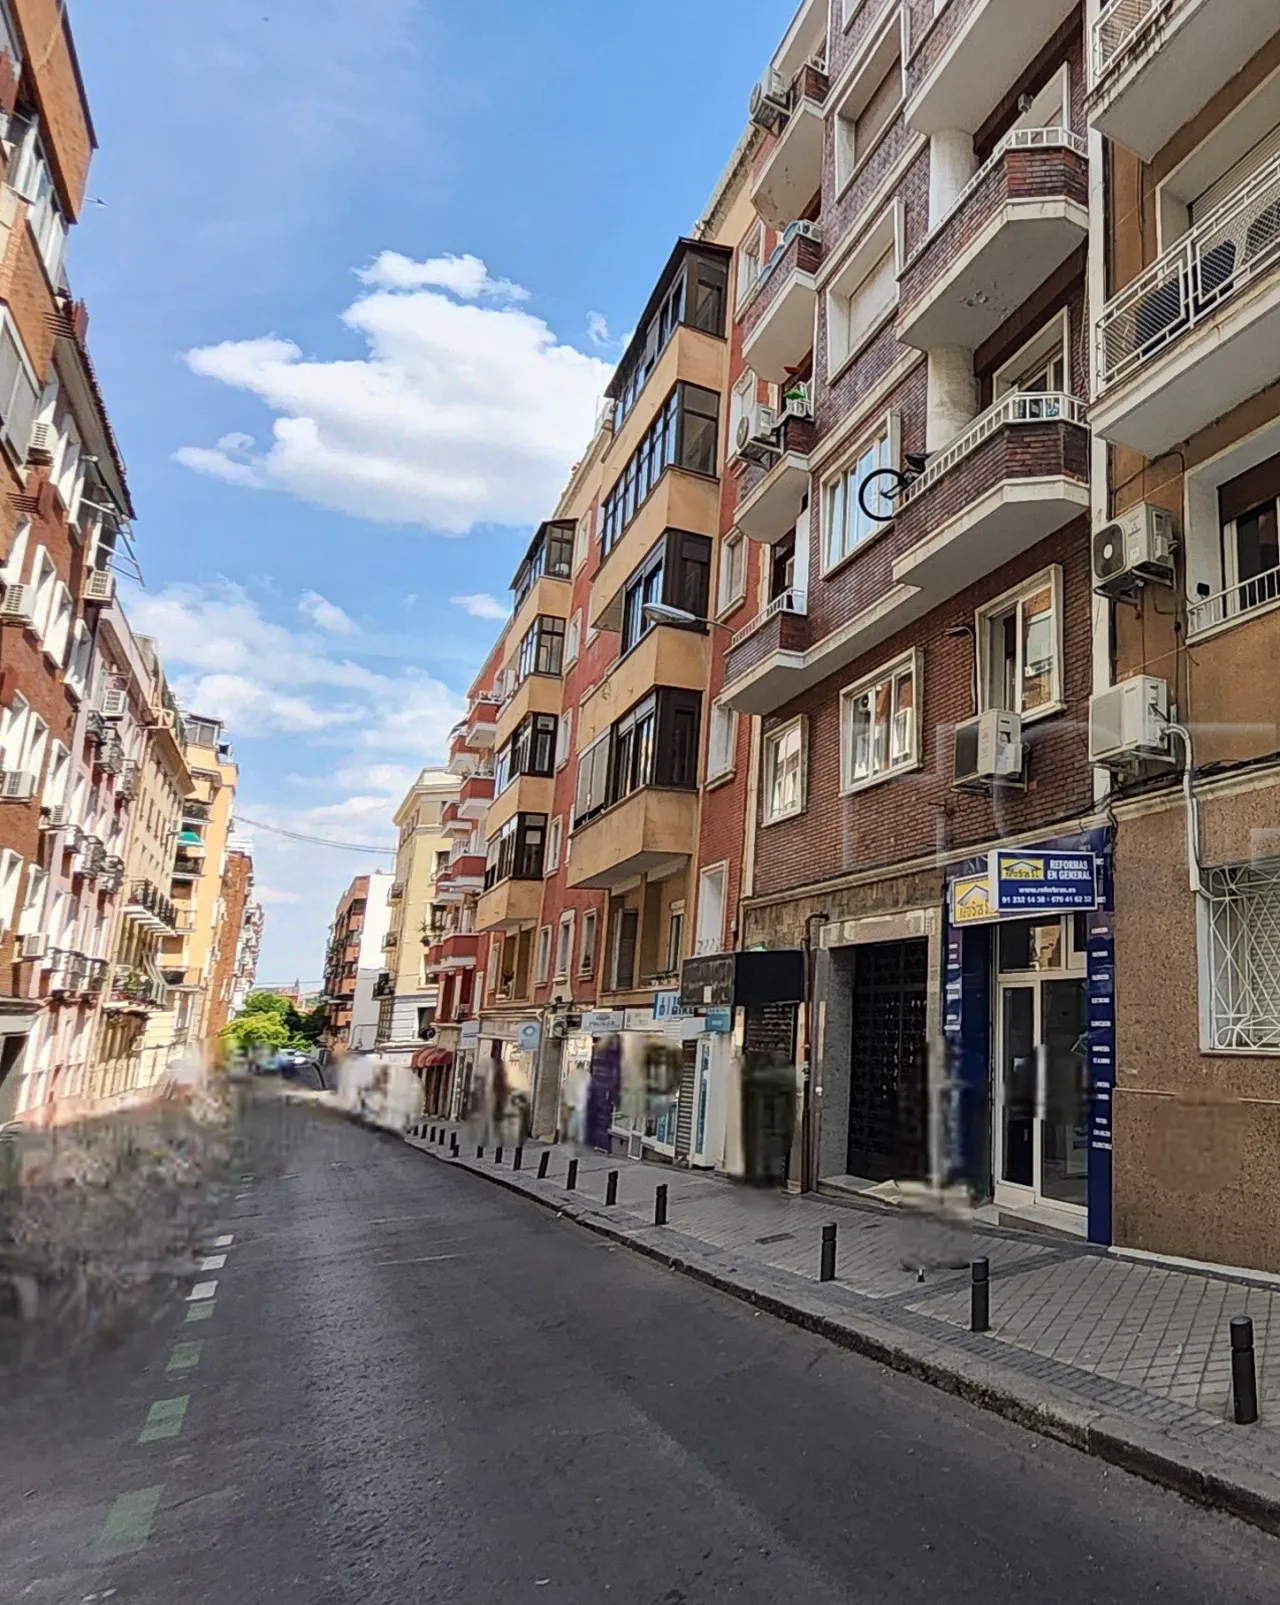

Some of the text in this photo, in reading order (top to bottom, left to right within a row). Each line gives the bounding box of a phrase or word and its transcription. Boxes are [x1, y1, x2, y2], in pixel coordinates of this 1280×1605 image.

[1049, 859, 1088, 869] REFORMAS
[1047, 870, 1092, 880] EN GENERAL
[1001, 896, 1011, 904] 91
